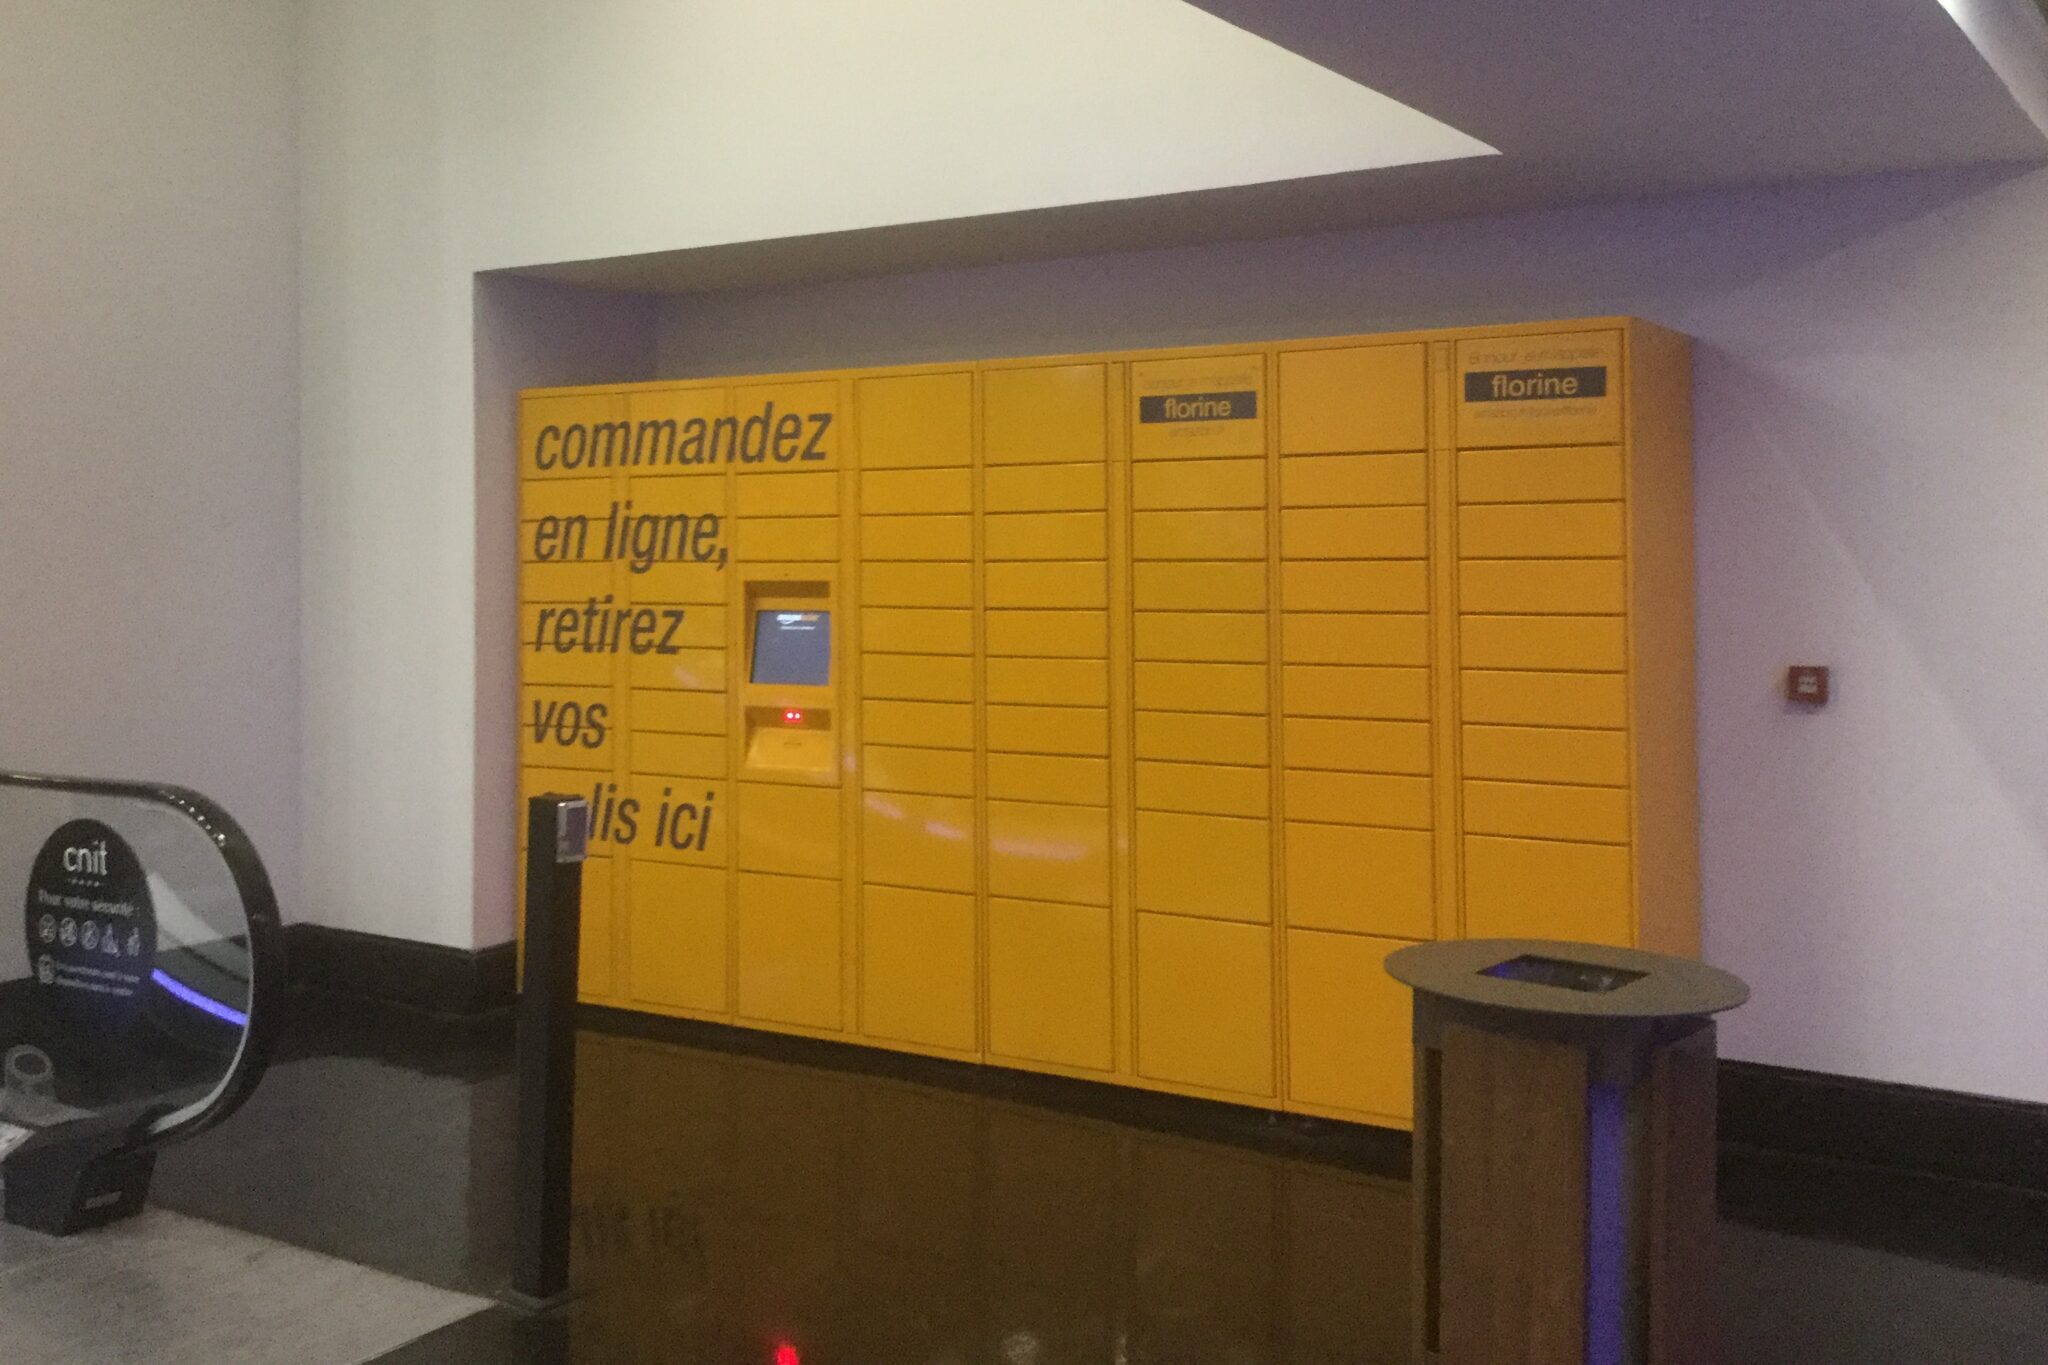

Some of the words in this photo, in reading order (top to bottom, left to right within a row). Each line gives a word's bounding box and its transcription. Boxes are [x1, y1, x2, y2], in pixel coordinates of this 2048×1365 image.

[1164, 396, 1232, 419] florine
[1491, 372, 1578, 398] florine
[535, 402, 832, 470] commandez
[534, 513, 587, 561] en
[604, 501, 728, 574] ligne,
[534, 594, 685, 655] retirez
[532, 699, 608, 749] vos
[589, 783, 641, 845] lis
[655, 787, 715, 851] ici
[63, 840, 108, 876] cnit
